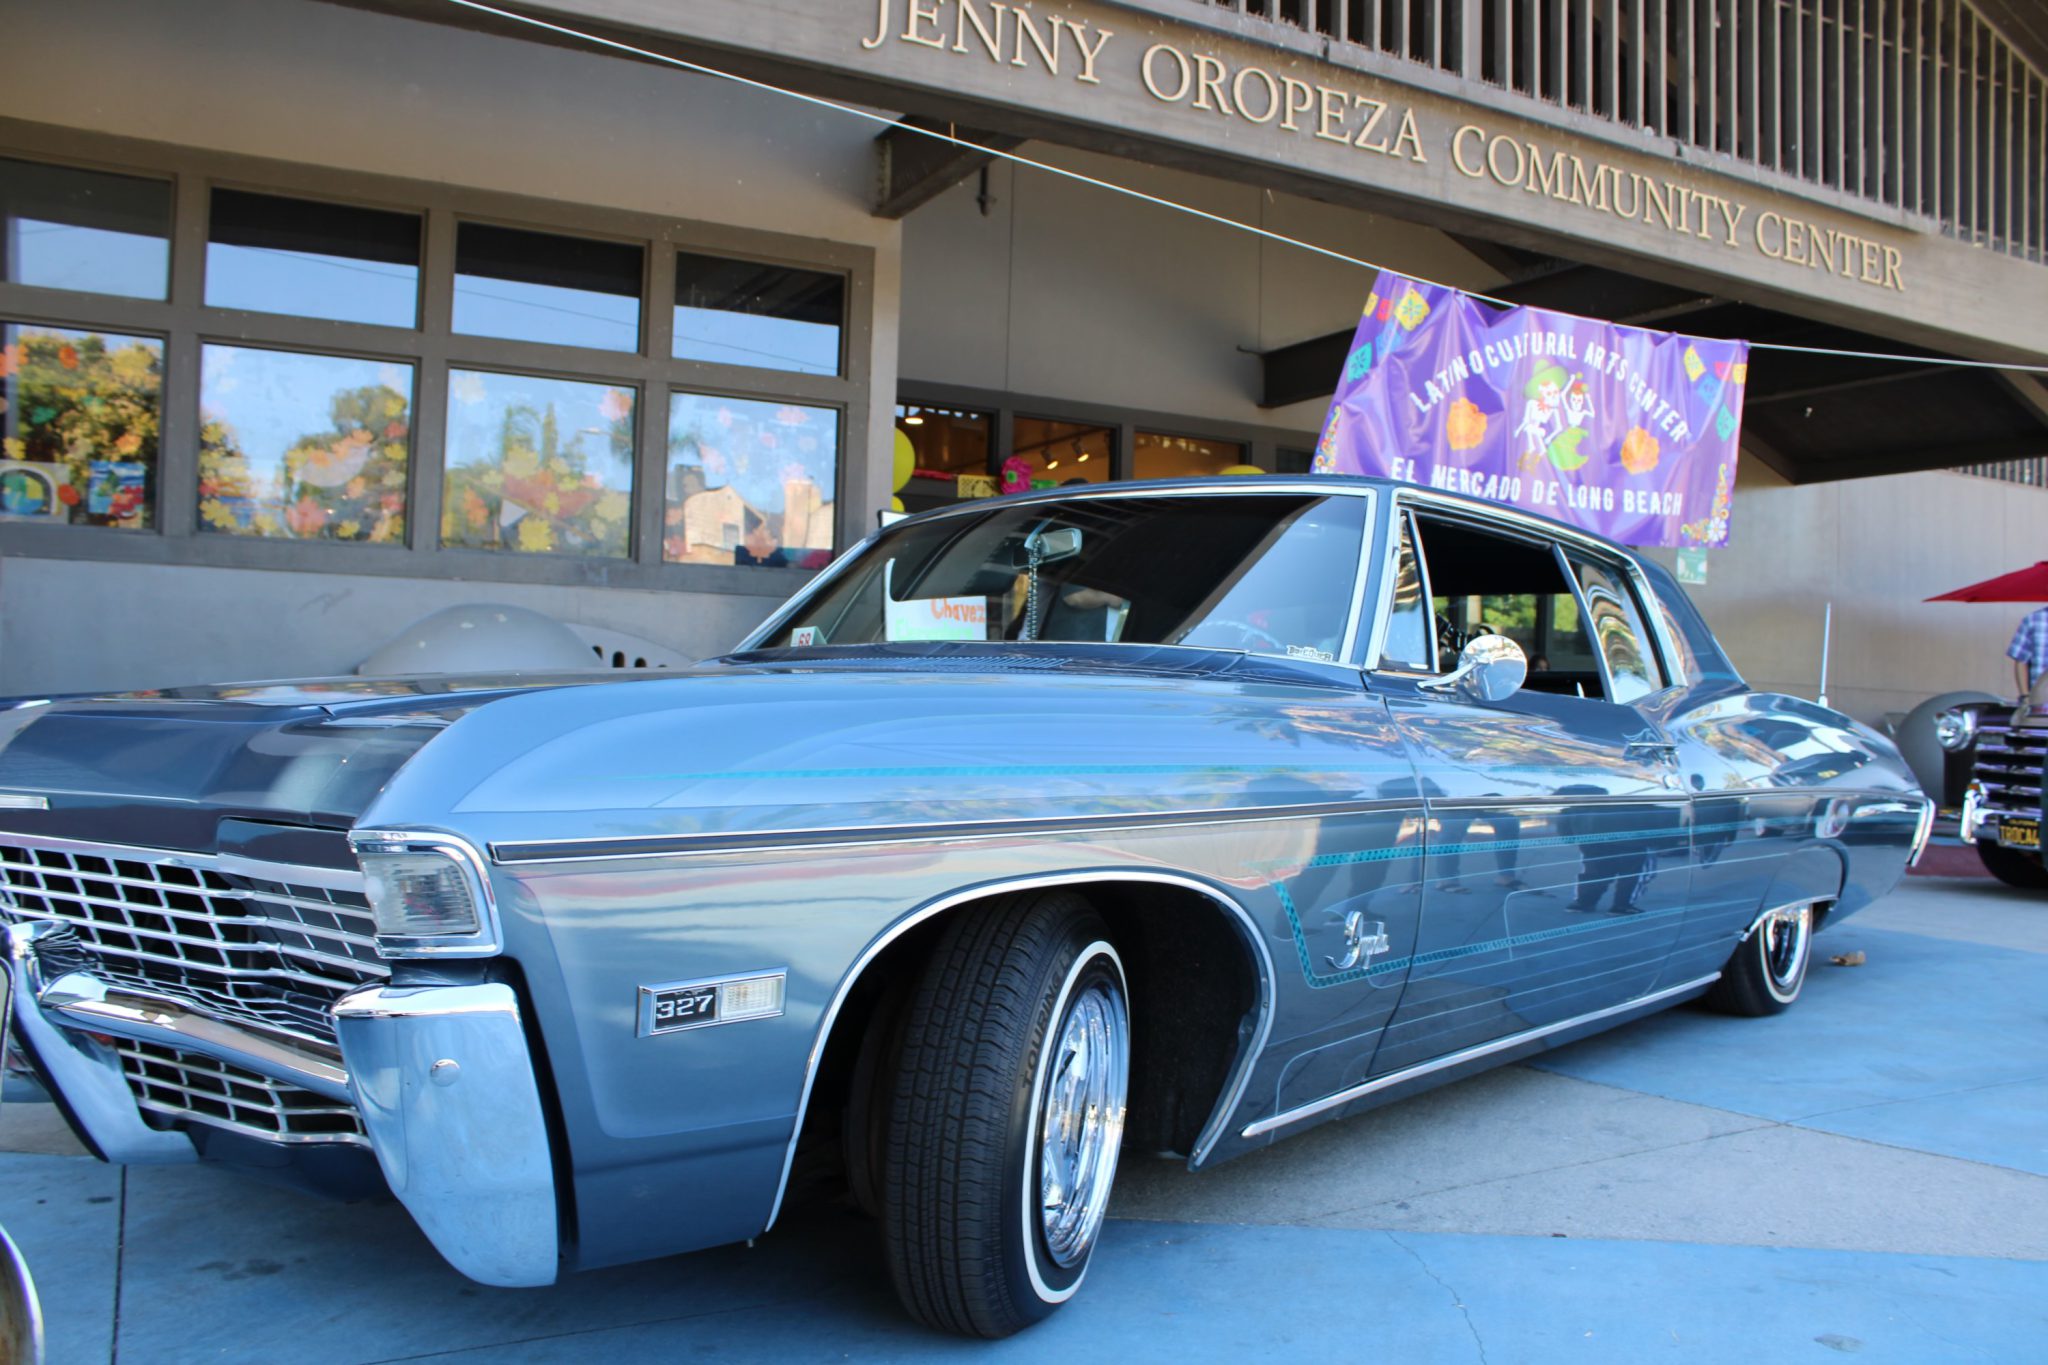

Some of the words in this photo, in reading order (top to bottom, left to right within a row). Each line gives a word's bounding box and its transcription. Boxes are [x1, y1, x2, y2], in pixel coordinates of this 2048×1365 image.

[861, 0, 1114, 84] JENNY
[1140, 42, 1428, 164] OROPEZA
[1451, 124, 1747, 248] COMMUNITY
[1754, 210, 1907, 292] CENTER
[1408, 349, 1485, 414] LATINO
[1484, 331, 1578, 369] CULTURAL
[1583, 340, 1630, 382] ARTS
[1628, 371, 1690, 444] CENTER
[1391, 456, 1418, 484] EL
[1430, 463, 1522, 503] MERCADO
[1532, 481, 1559, 507] DE
[1567, 485, 1614, 513] LONG
[1623, 489, 1683, 517] BEACH
[655, 994, 715, 1020] 327
[1021, 968, 1064, 1089] TOURING
